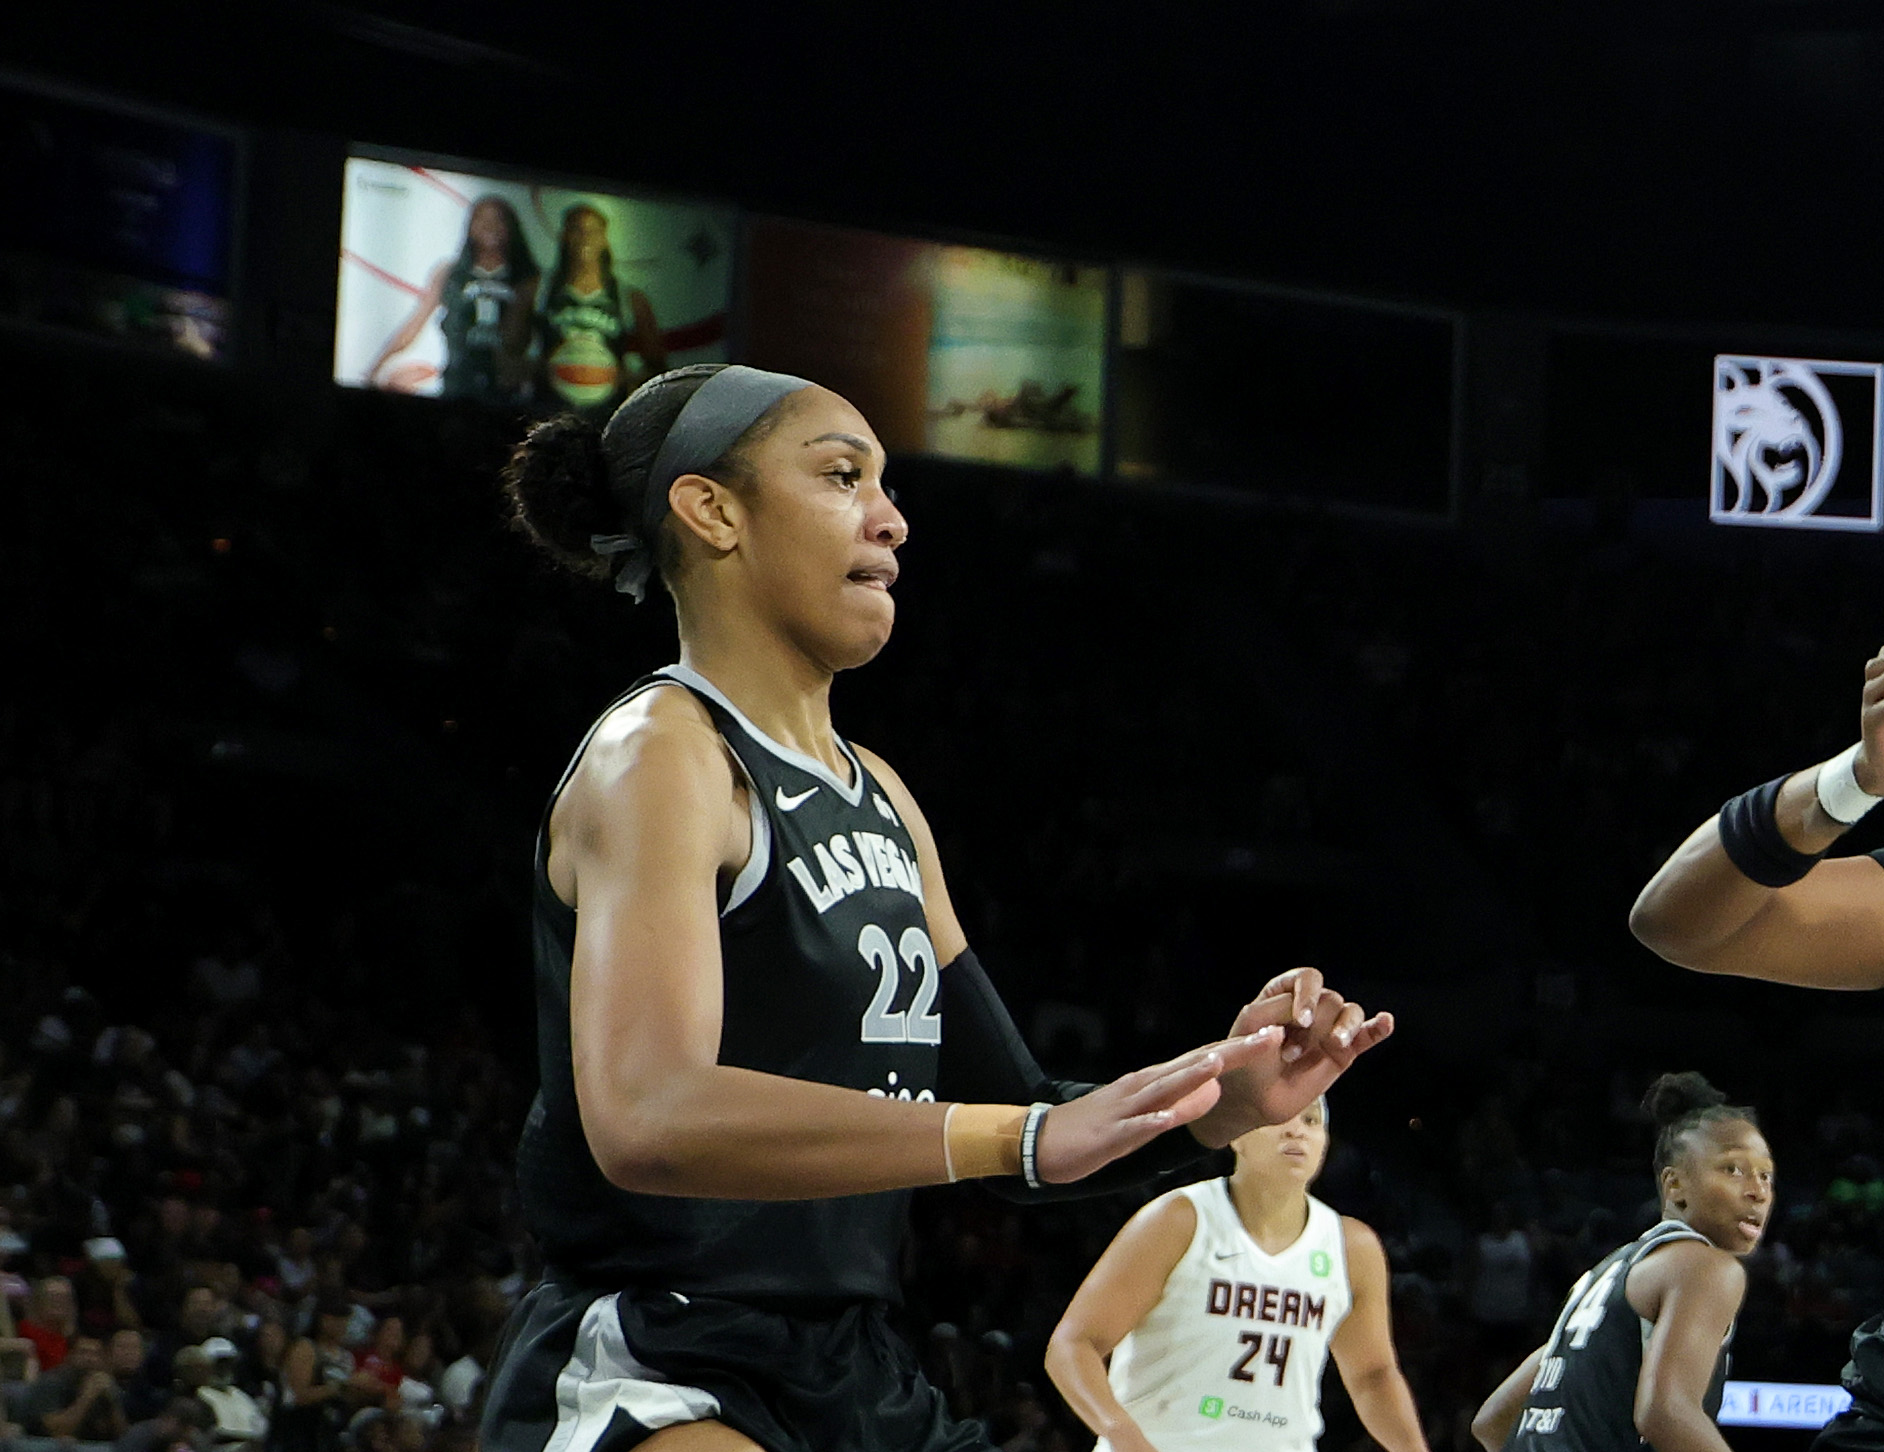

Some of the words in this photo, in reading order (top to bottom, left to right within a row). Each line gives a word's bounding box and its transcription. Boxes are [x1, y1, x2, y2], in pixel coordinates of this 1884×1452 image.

[787, 834, 866, 915] LAS
[852, 831, 925, 907] VEGA
[858, 924, 941, 1044] 22
[1206, 1277, 1327, 1332] DREAM
[1228, 1330, 1293, 1388] 24
[1226, 1404, 1262, 1423] Cash
[1262, 1411, 1289, 1428] App
